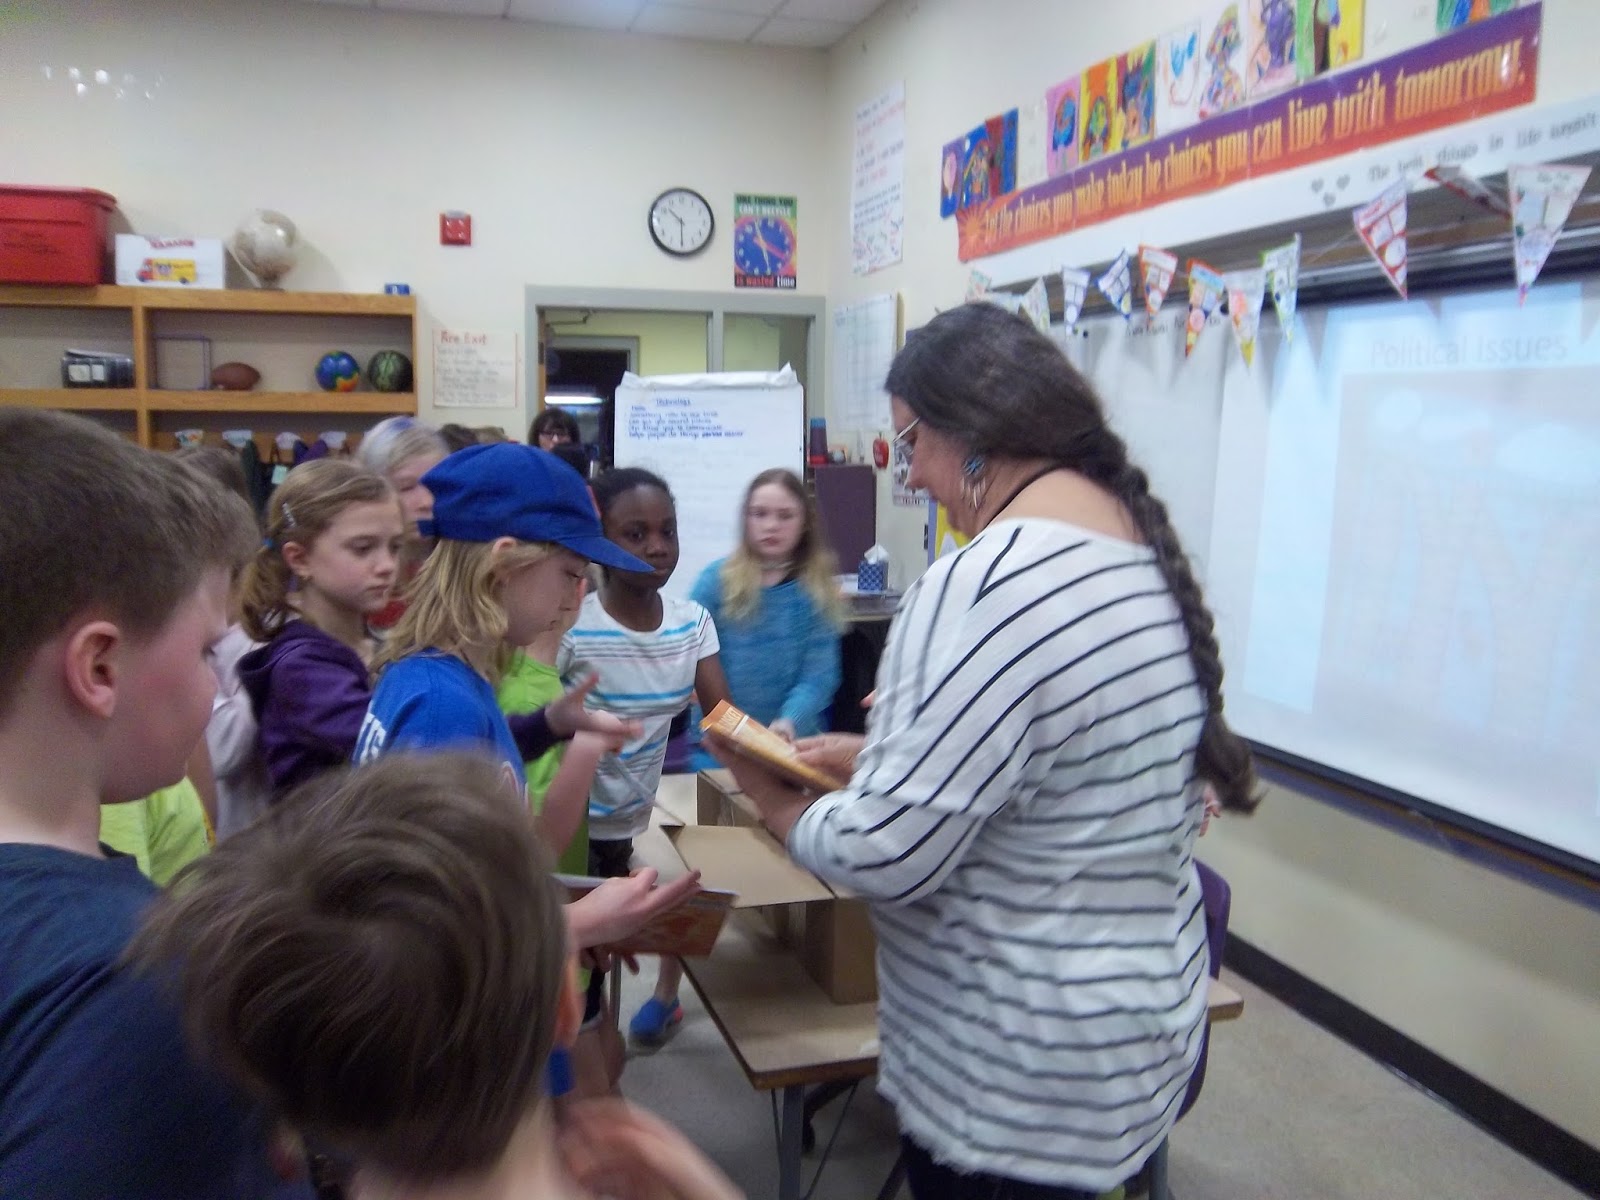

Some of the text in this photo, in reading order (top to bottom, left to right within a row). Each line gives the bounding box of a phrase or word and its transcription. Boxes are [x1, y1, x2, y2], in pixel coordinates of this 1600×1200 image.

[1075, 171, 1104, 215] make
[1107, 160, 1144, 208] today
[1145, 151, 1162, 195] be
[1164, 137, 1213, 192] choices
[1215, 131, 1248, 186] you
[1252, 116, 1283, 162] can
[1288, 97, 1329, 153] live
[1333, 71, 1386, 139] with
[1395, 38, 1525, 121] tomorrow.
[776, 275, 796, 288] time
[1370, 333, 1569, 368] Political Issues
